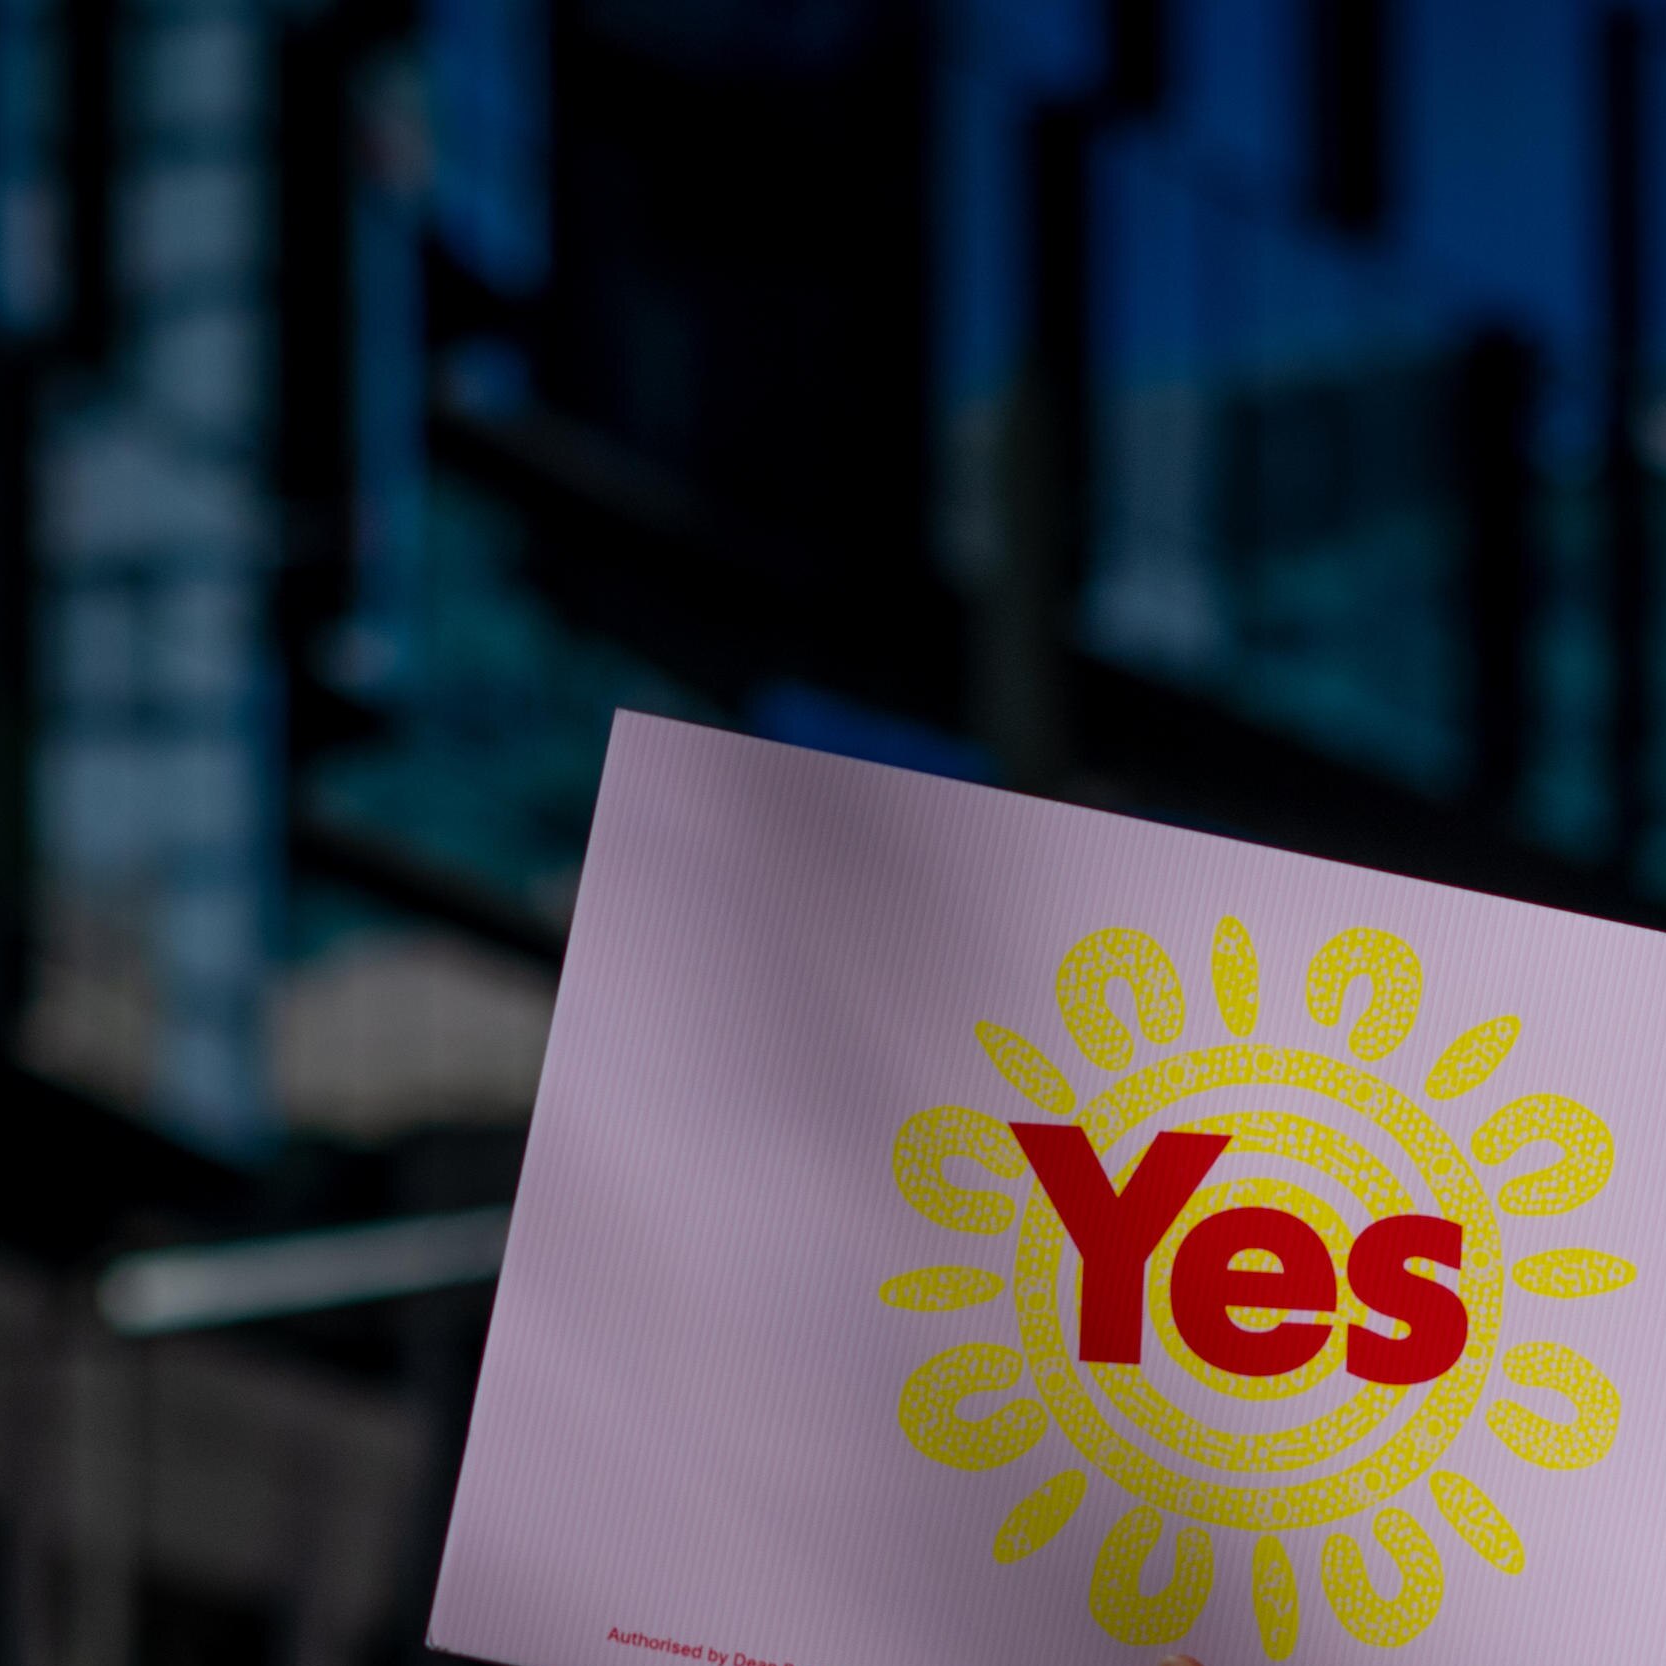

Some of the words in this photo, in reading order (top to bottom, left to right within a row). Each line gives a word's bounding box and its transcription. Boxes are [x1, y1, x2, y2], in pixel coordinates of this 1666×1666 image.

[1009, 1122, 1468, 1385] Yes
[607, 1627, 703, 1659] Authorised
[707, 1648, 729, 1666] by
